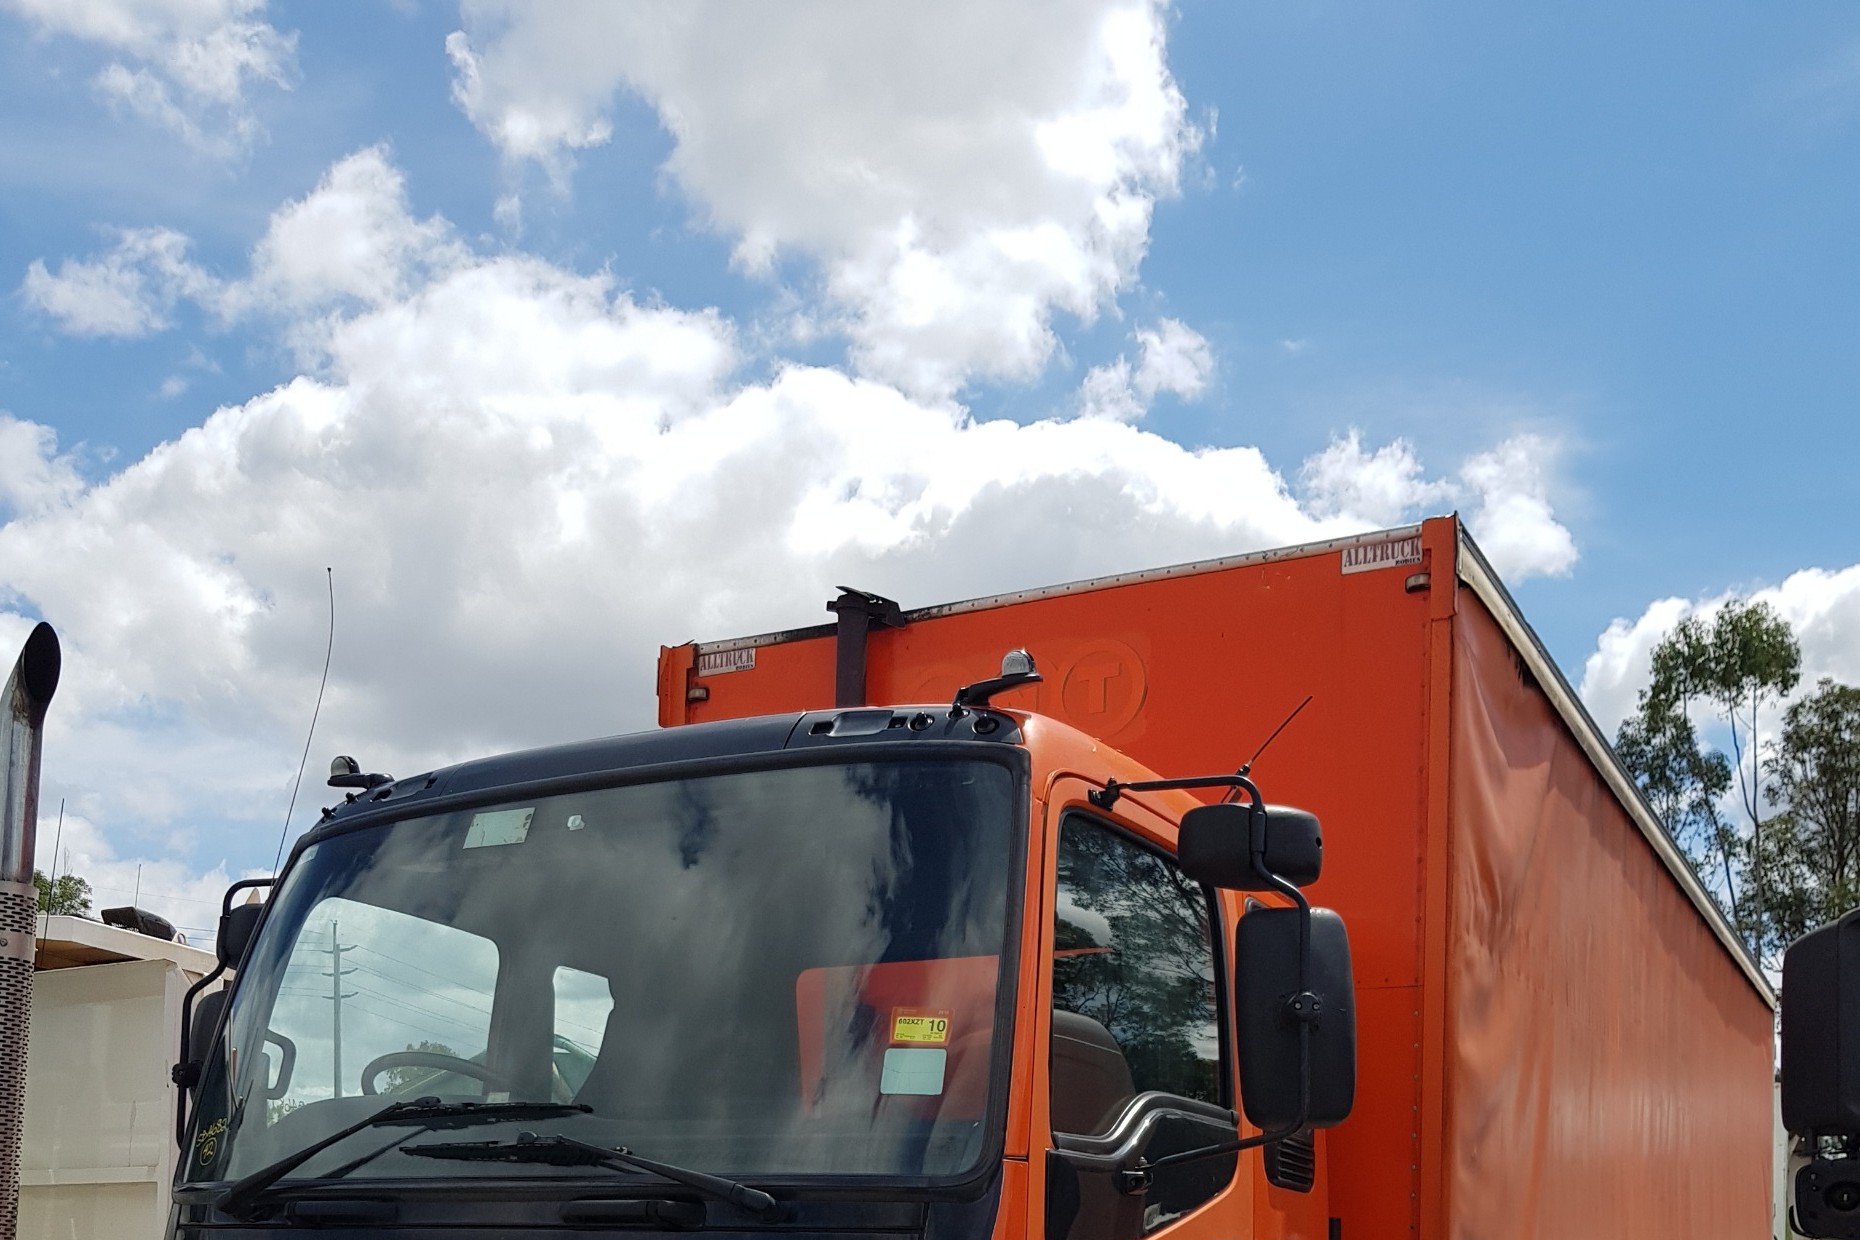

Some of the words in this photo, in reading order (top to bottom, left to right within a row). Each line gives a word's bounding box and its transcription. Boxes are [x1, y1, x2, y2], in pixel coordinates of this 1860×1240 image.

[1344, 537, 1421, 568] ALLTRUCK
[700, 647, 755, 671] ALLTRUCK
[929, 1018, 946, 1032] 10
